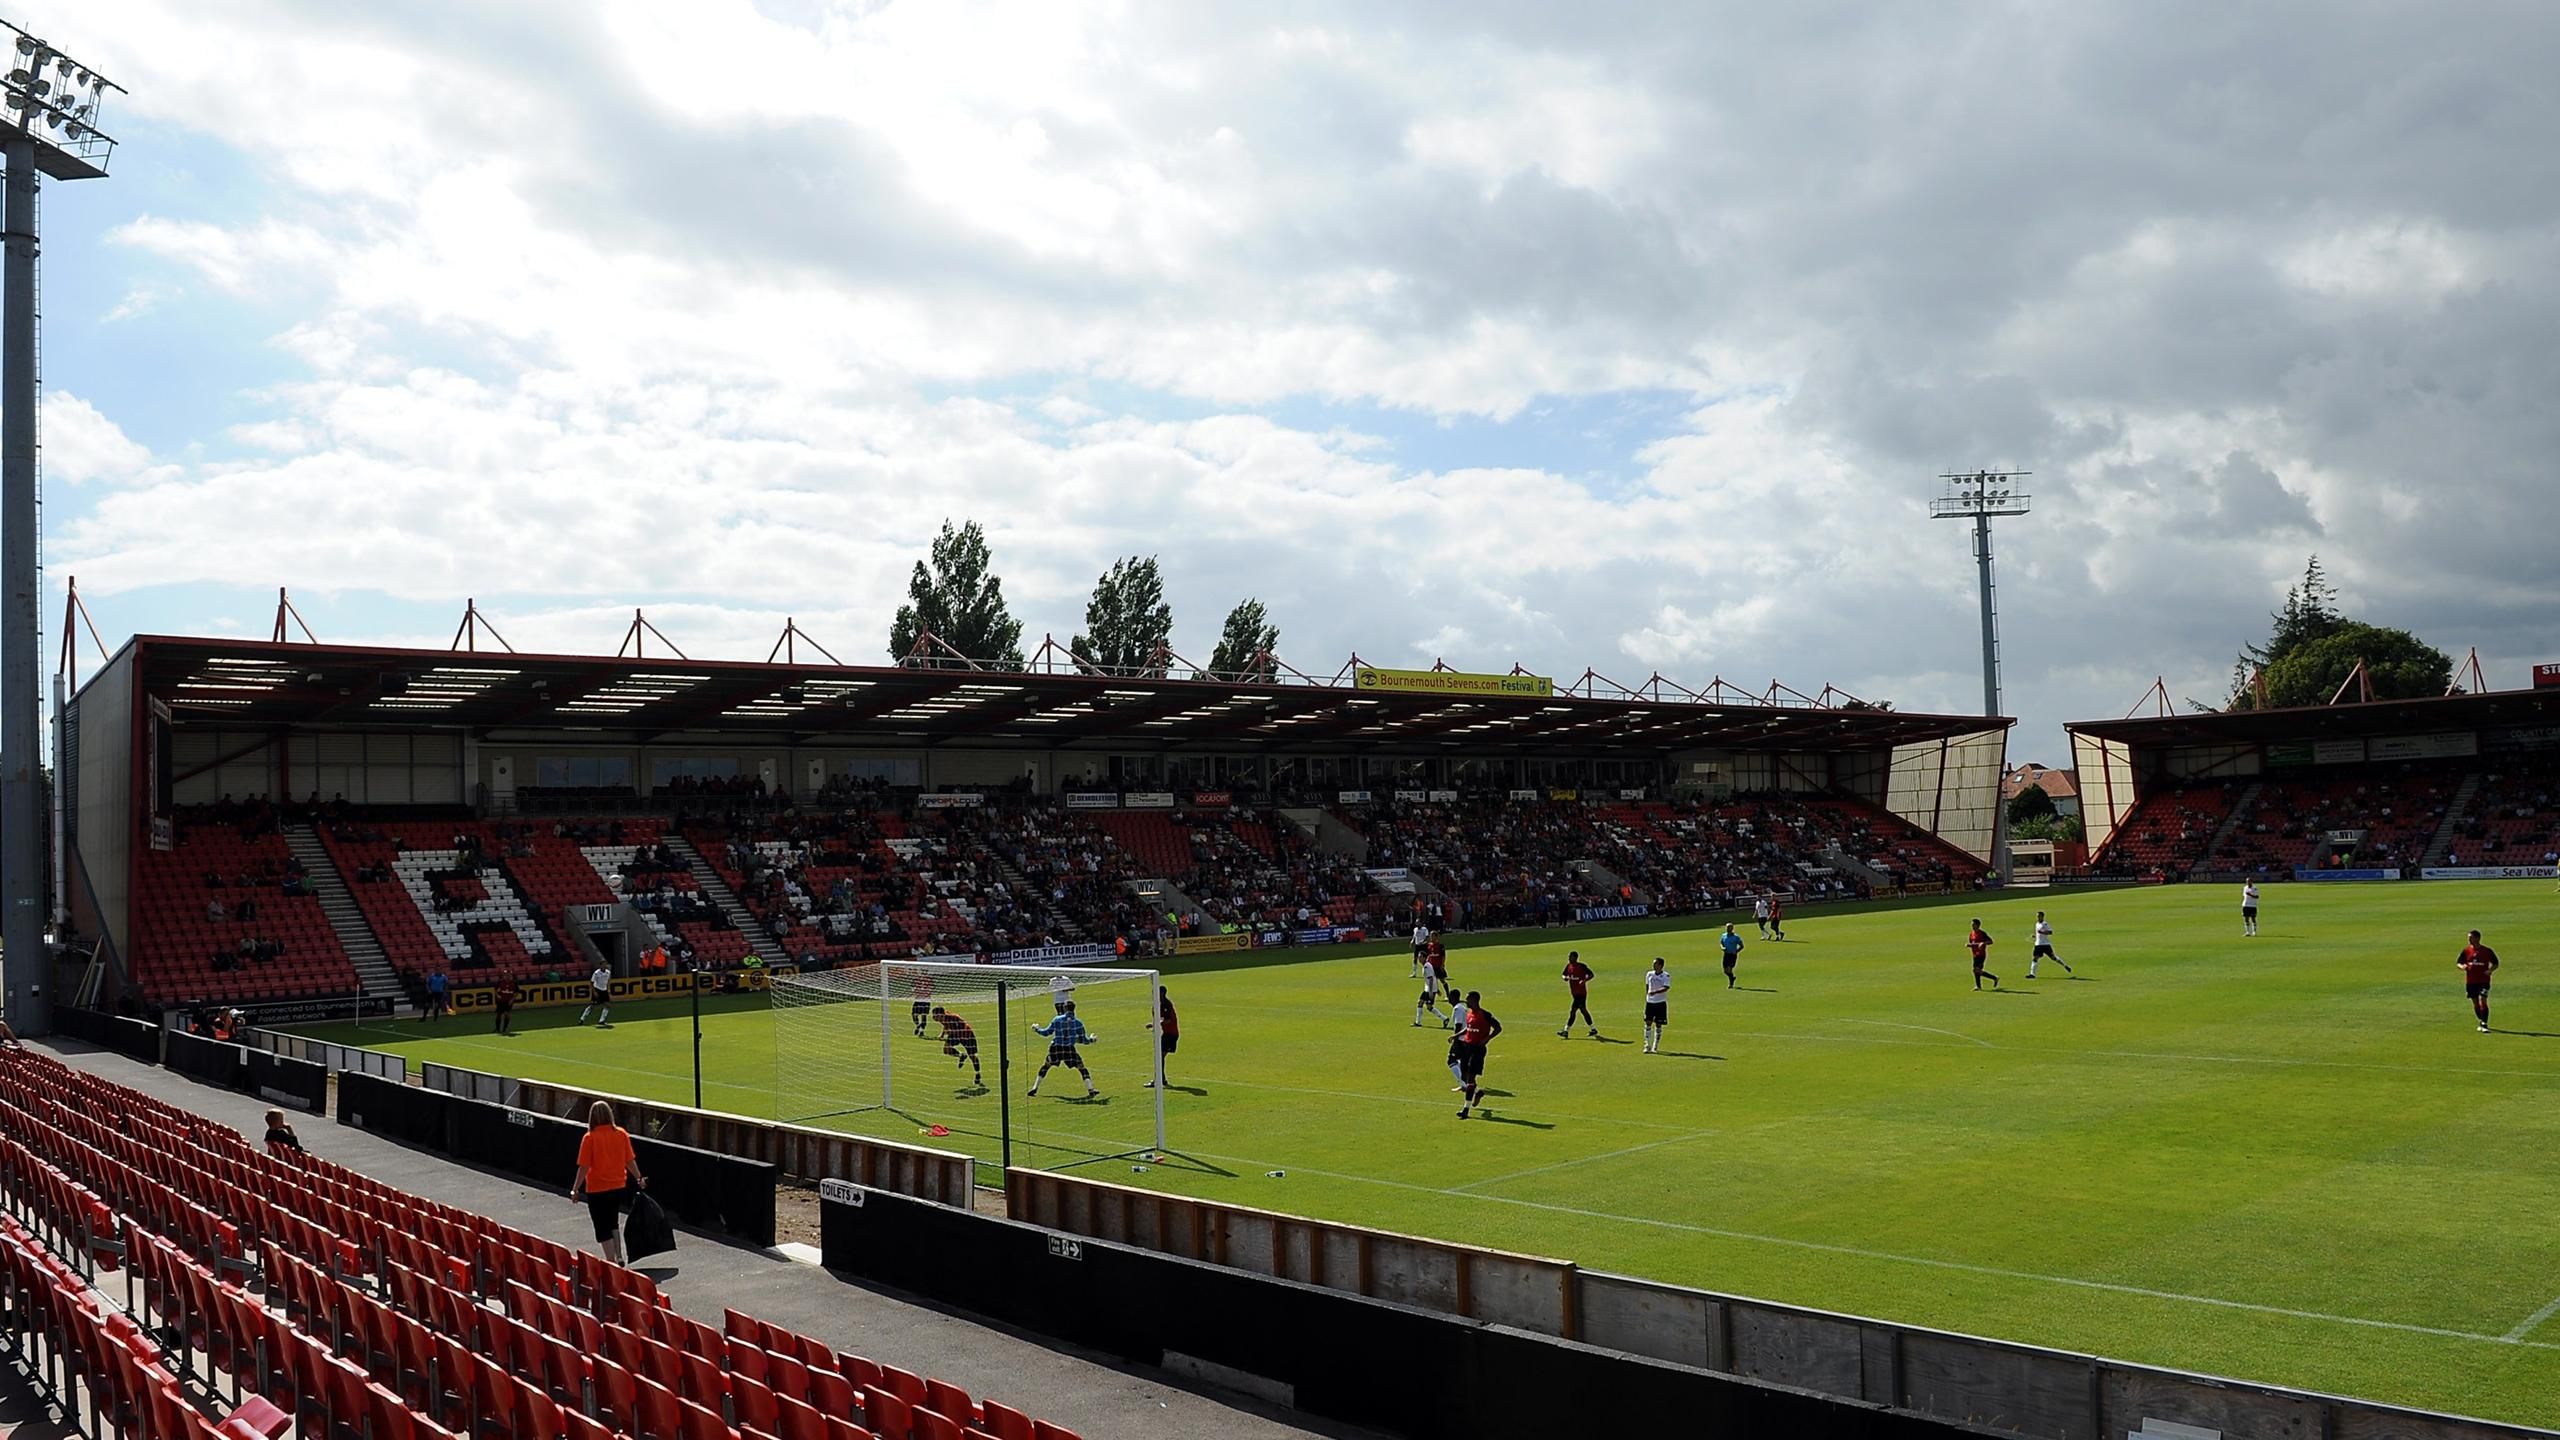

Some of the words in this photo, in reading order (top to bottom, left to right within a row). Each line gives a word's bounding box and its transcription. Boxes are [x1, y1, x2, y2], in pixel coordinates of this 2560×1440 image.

[1380, 674, 1445, 688] Bournemouth
[1447, 676, 1499, 690] Sevens.com
[1501, 680, 1535, 692] Festival
[2502, 867, 2522, 877] Sea
[2526, 867, 2554, 877] View
[588, 905, 611, 921] WV1
[1594, 906, 1627, 919] VODKA
[1628, 904, 1649, 917] KICK
[259, 1004, 304, 1016] connected
[305, 1002, 316, 1011] to
[821, 1183, 851, 1201] TOILETS
